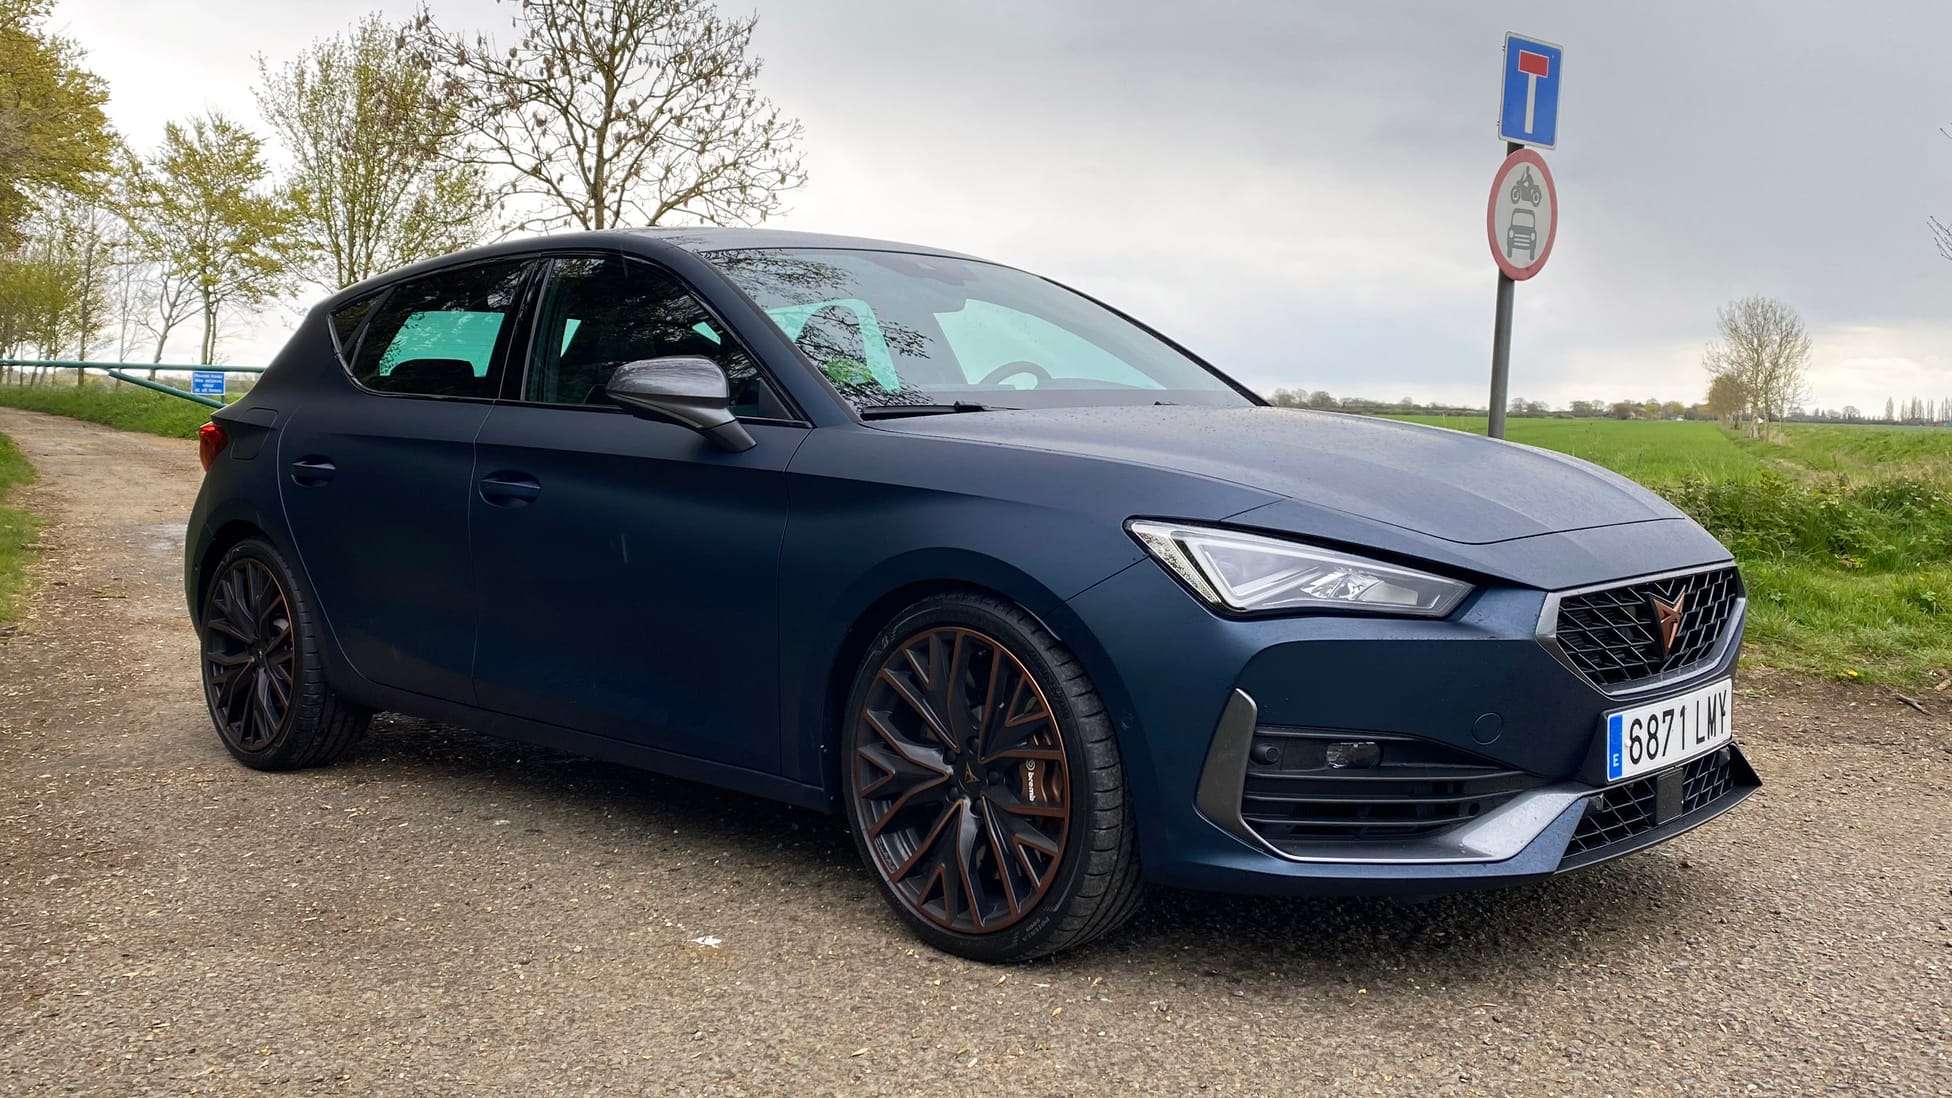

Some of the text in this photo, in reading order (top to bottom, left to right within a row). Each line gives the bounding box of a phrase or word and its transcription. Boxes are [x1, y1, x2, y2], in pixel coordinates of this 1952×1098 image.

[1629, 690, 1727, 765] 6871 LMY
[1613, 753, 1619, 767] E
[1027, 771, 1036, 801] bremb
